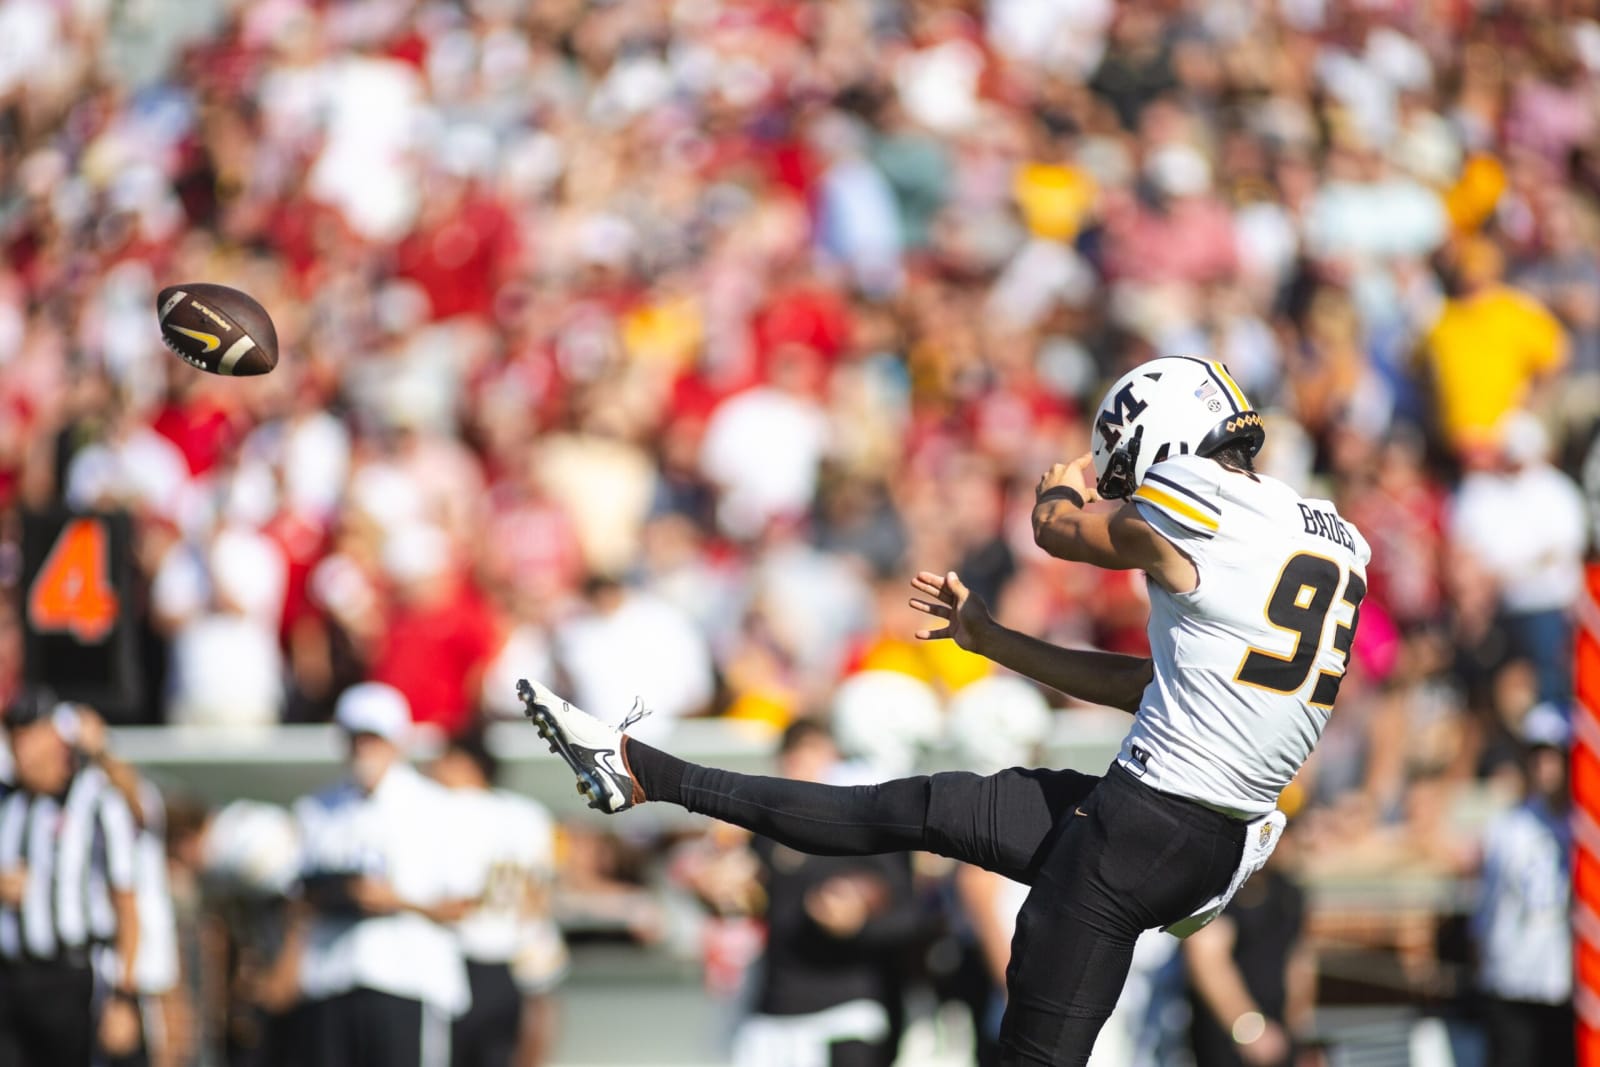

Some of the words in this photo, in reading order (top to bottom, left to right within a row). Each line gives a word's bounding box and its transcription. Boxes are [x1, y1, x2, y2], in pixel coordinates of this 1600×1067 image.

[1099, 381, 1148, 453] M
[1297, 502, 1356, 556] BAUE
[28, 516, 119, 643] 4
[1232, 550, 1367, 709] 93
